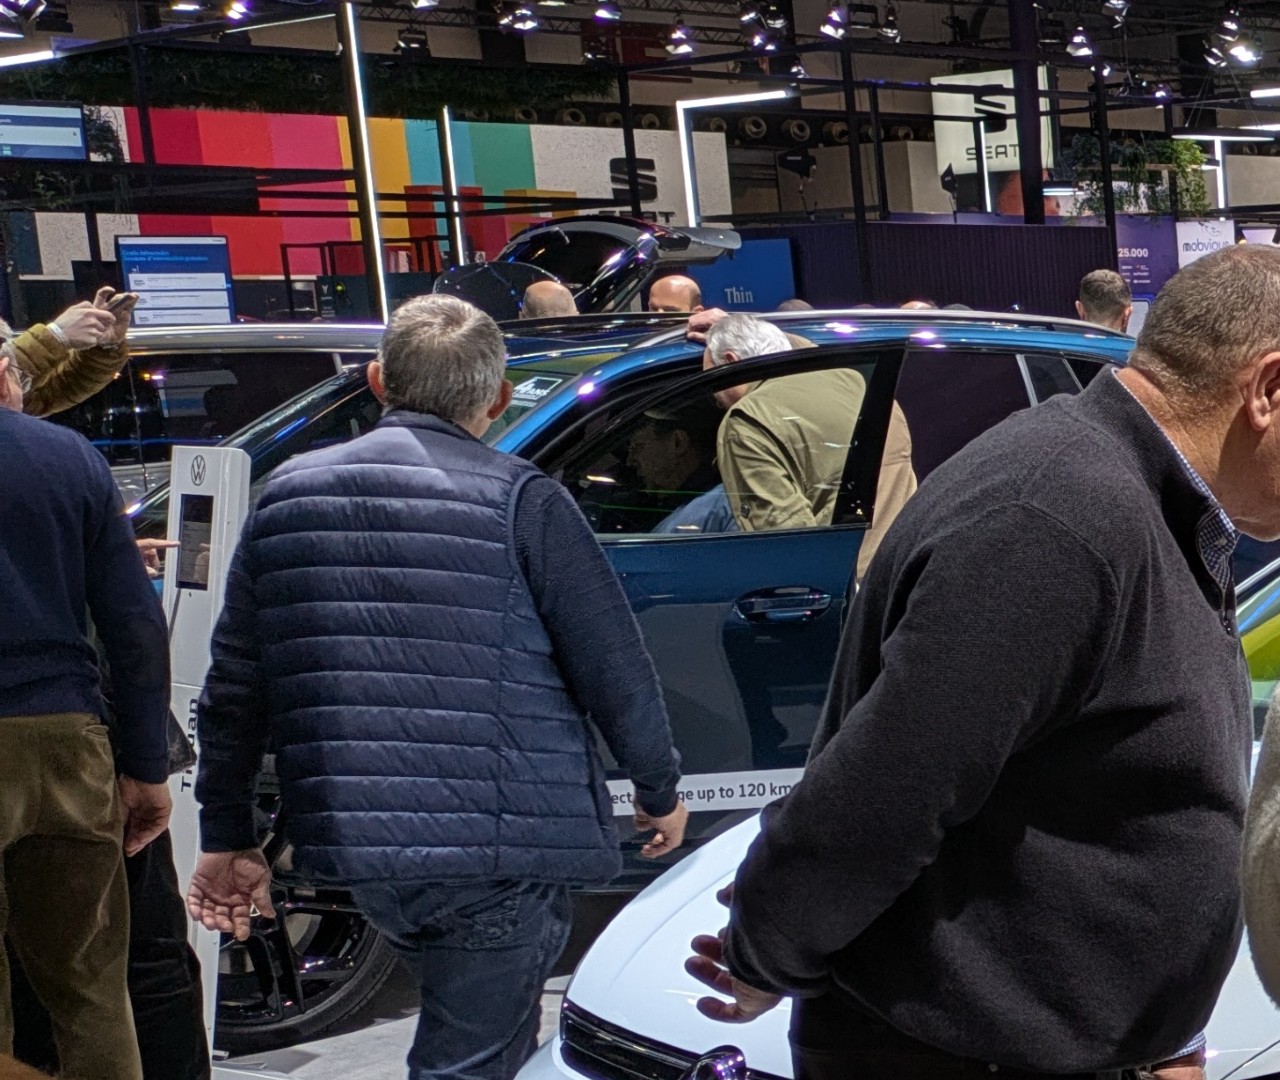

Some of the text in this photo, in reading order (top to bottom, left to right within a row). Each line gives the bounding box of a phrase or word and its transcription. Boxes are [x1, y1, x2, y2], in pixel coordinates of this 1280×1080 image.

[965, 144, 1020, 161] SEAT
[1117, 248, 1149, 258] 25.000
[724, 288, 754, 304] Thin
[181, 698, 198, 793] Tiuan
[697, 789, 716, 803] up
[718, 786, 735, 799] to
[739, 782, 767, 798] 120
[769, 781, 793, 796] km
